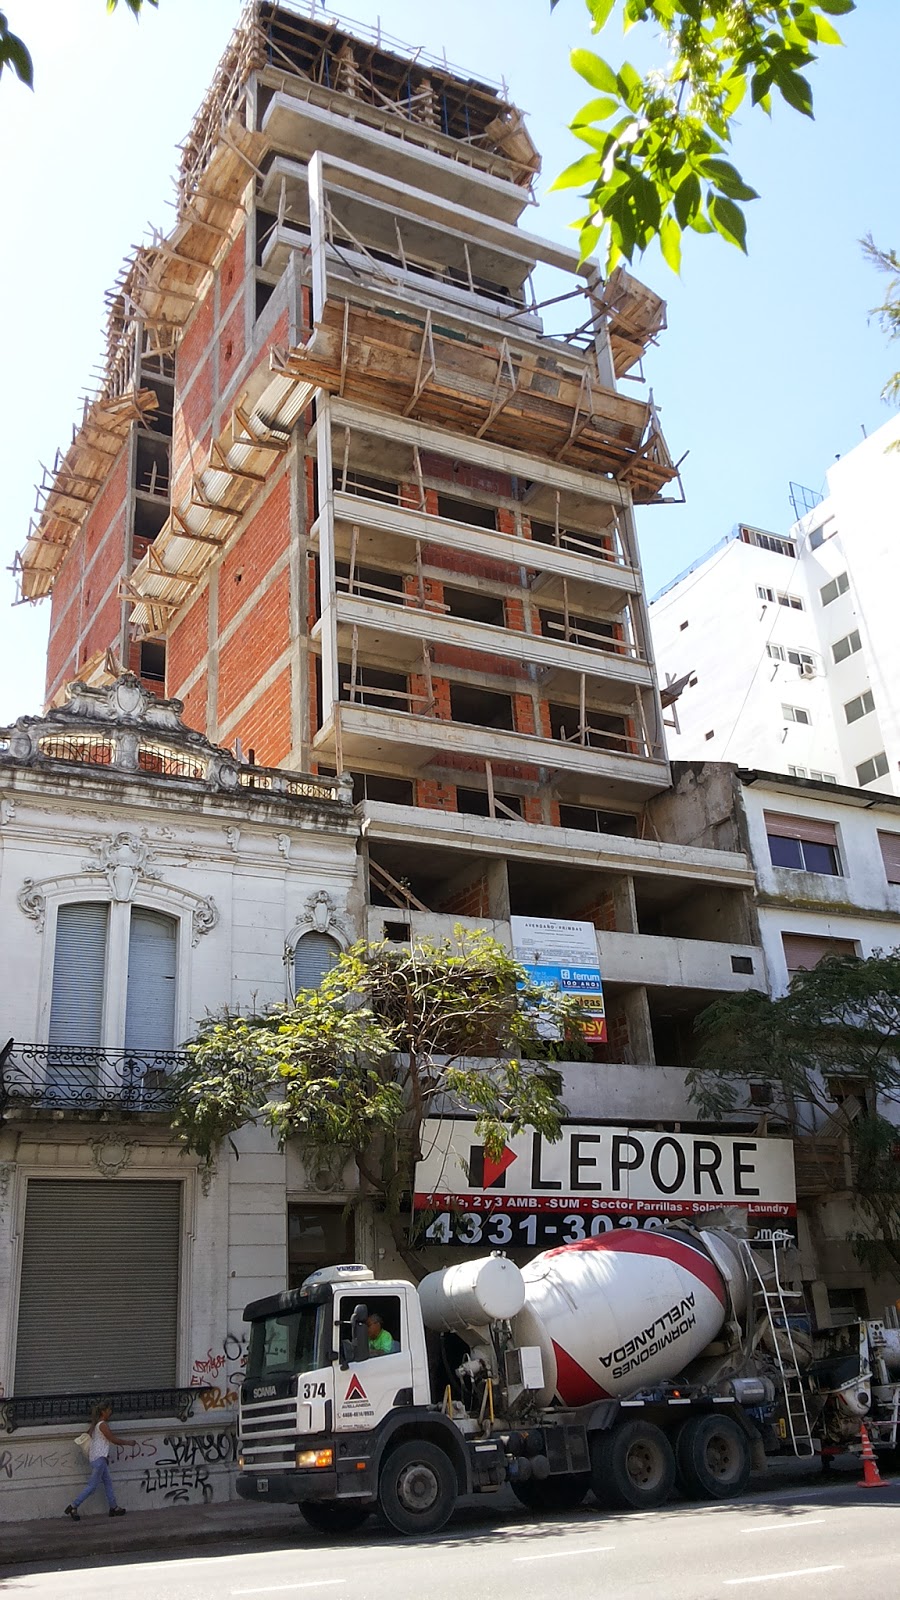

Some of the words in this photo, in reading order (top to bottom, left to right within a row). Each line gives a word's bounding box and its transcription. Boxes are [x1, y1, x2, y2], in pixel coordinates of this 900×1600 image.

[573, 971, 600, 981] ferrum
[531, 1131, 760, 1196] LEPORE
[473, 1196, 482, 1206] 2
[484, 1199, 493, 1209] y
[494, 1197, 503, 1207] 3
[506, 1198, 541, 1208] AMB.
[591, 1199, 634, 1209] Sector
[636, 1200, 683, 1211] Parrillas
[692, 1202, 739, 1212] Solar
[747, 1203, 789, 1215] Laundry
[598, 1291, 696, 1369] AVELLANEDA
[612, 1312, 697, 1379] HORMIGONES
[253, 1385, 277, 1399] SCANIA
[303, 1382, 327, 1399] 374
